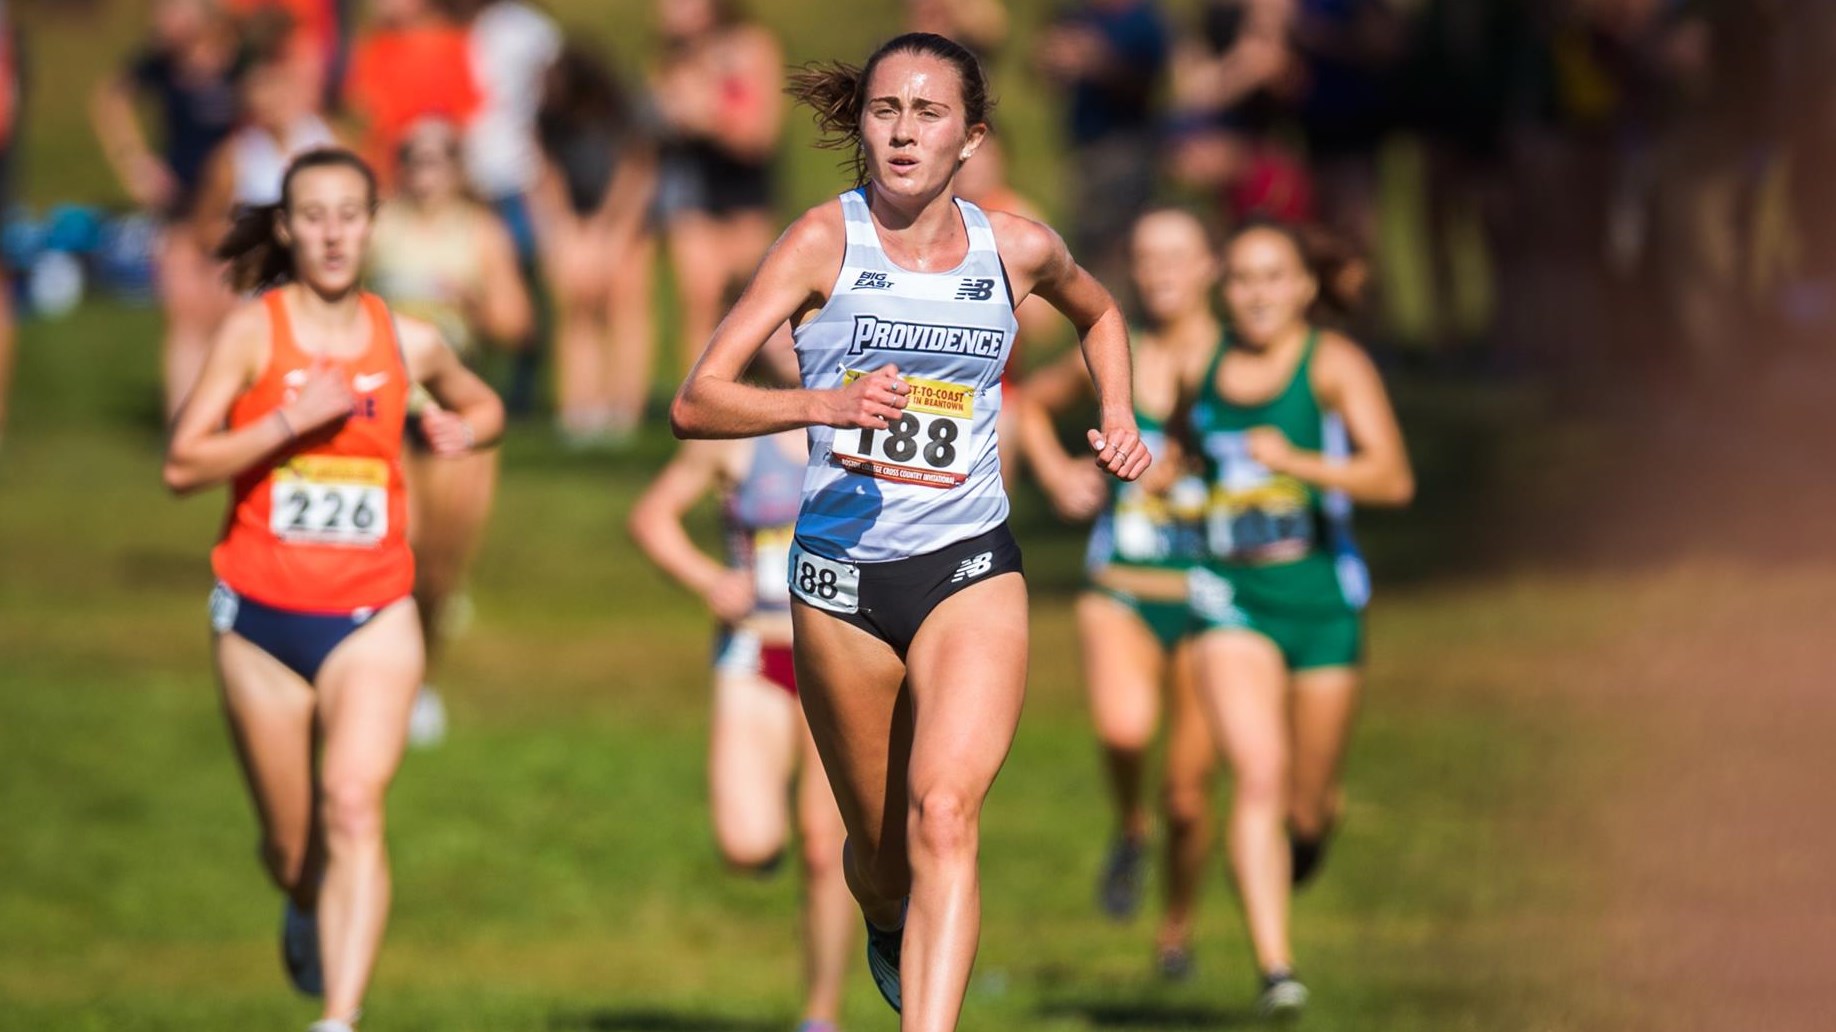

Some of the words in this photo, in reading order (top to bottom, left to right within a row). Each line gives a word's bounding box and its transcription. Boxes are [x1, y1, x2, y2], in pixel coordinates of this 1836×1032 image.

[854, 279, 895, 288] EAST
[859, 271, 887, 281] BIG
[848, 315, 1004, 359] PROVIDENCE
[924, 397, 964, 411] BEANTOWN
[857, 412, 959, 468] 188
[883, 467, 899, 477] CROSS
[288, 490, 375, 530] 226
[793, 554, 838, 599] 188
